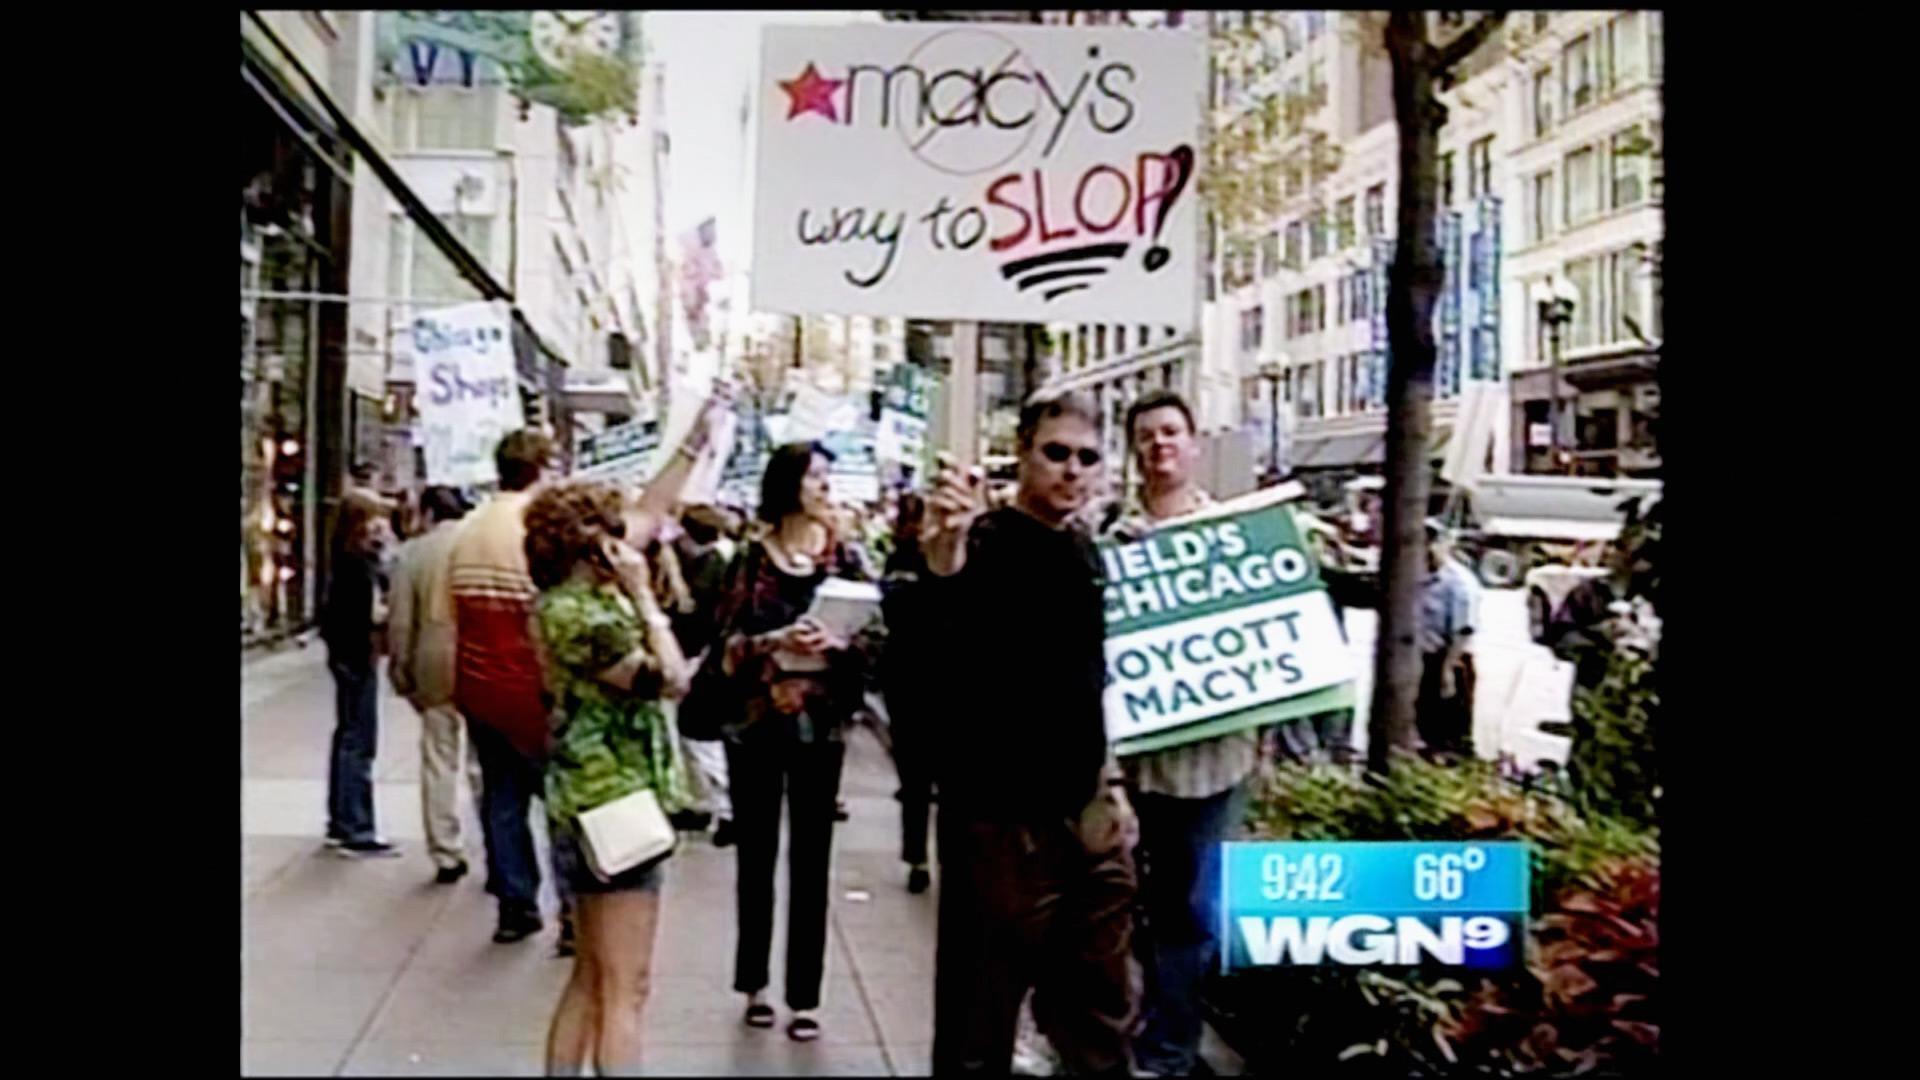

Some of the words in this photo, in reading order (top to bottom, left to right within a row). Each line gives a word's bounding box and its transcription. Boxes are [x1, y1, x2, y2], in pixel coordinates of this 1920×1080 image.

[844, 46, 1136, 157] macy's
[799, 205, 904, 288] way
[921, 196, 987, 250] to
[1102, 521, 1247, 583] IELD'S
[1105, 610, 1302, 685] OYCOTT
[1122, 652, 1303, 723] MACY'S
